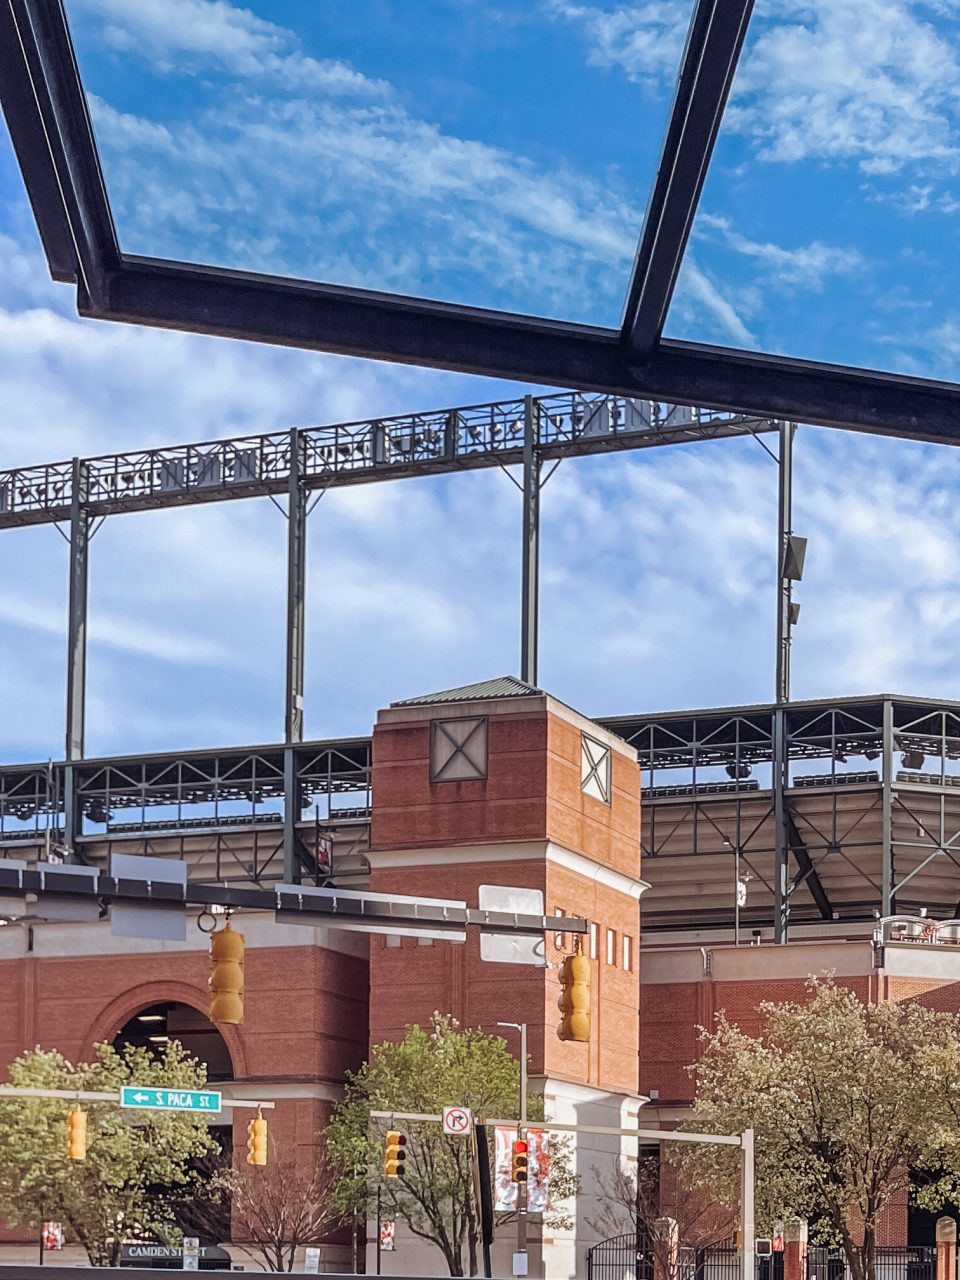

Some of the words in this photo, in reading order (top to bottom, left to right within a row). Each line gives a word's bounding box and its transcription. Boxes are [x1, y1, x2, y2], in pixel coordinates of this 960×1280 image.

[156, 1092, 165, 1105] S.
[167, 1093, 193, 1107] PACA
[128, 1246, 170, 1257] CAMDEN
[171, 1246, 207, 1257] STT
